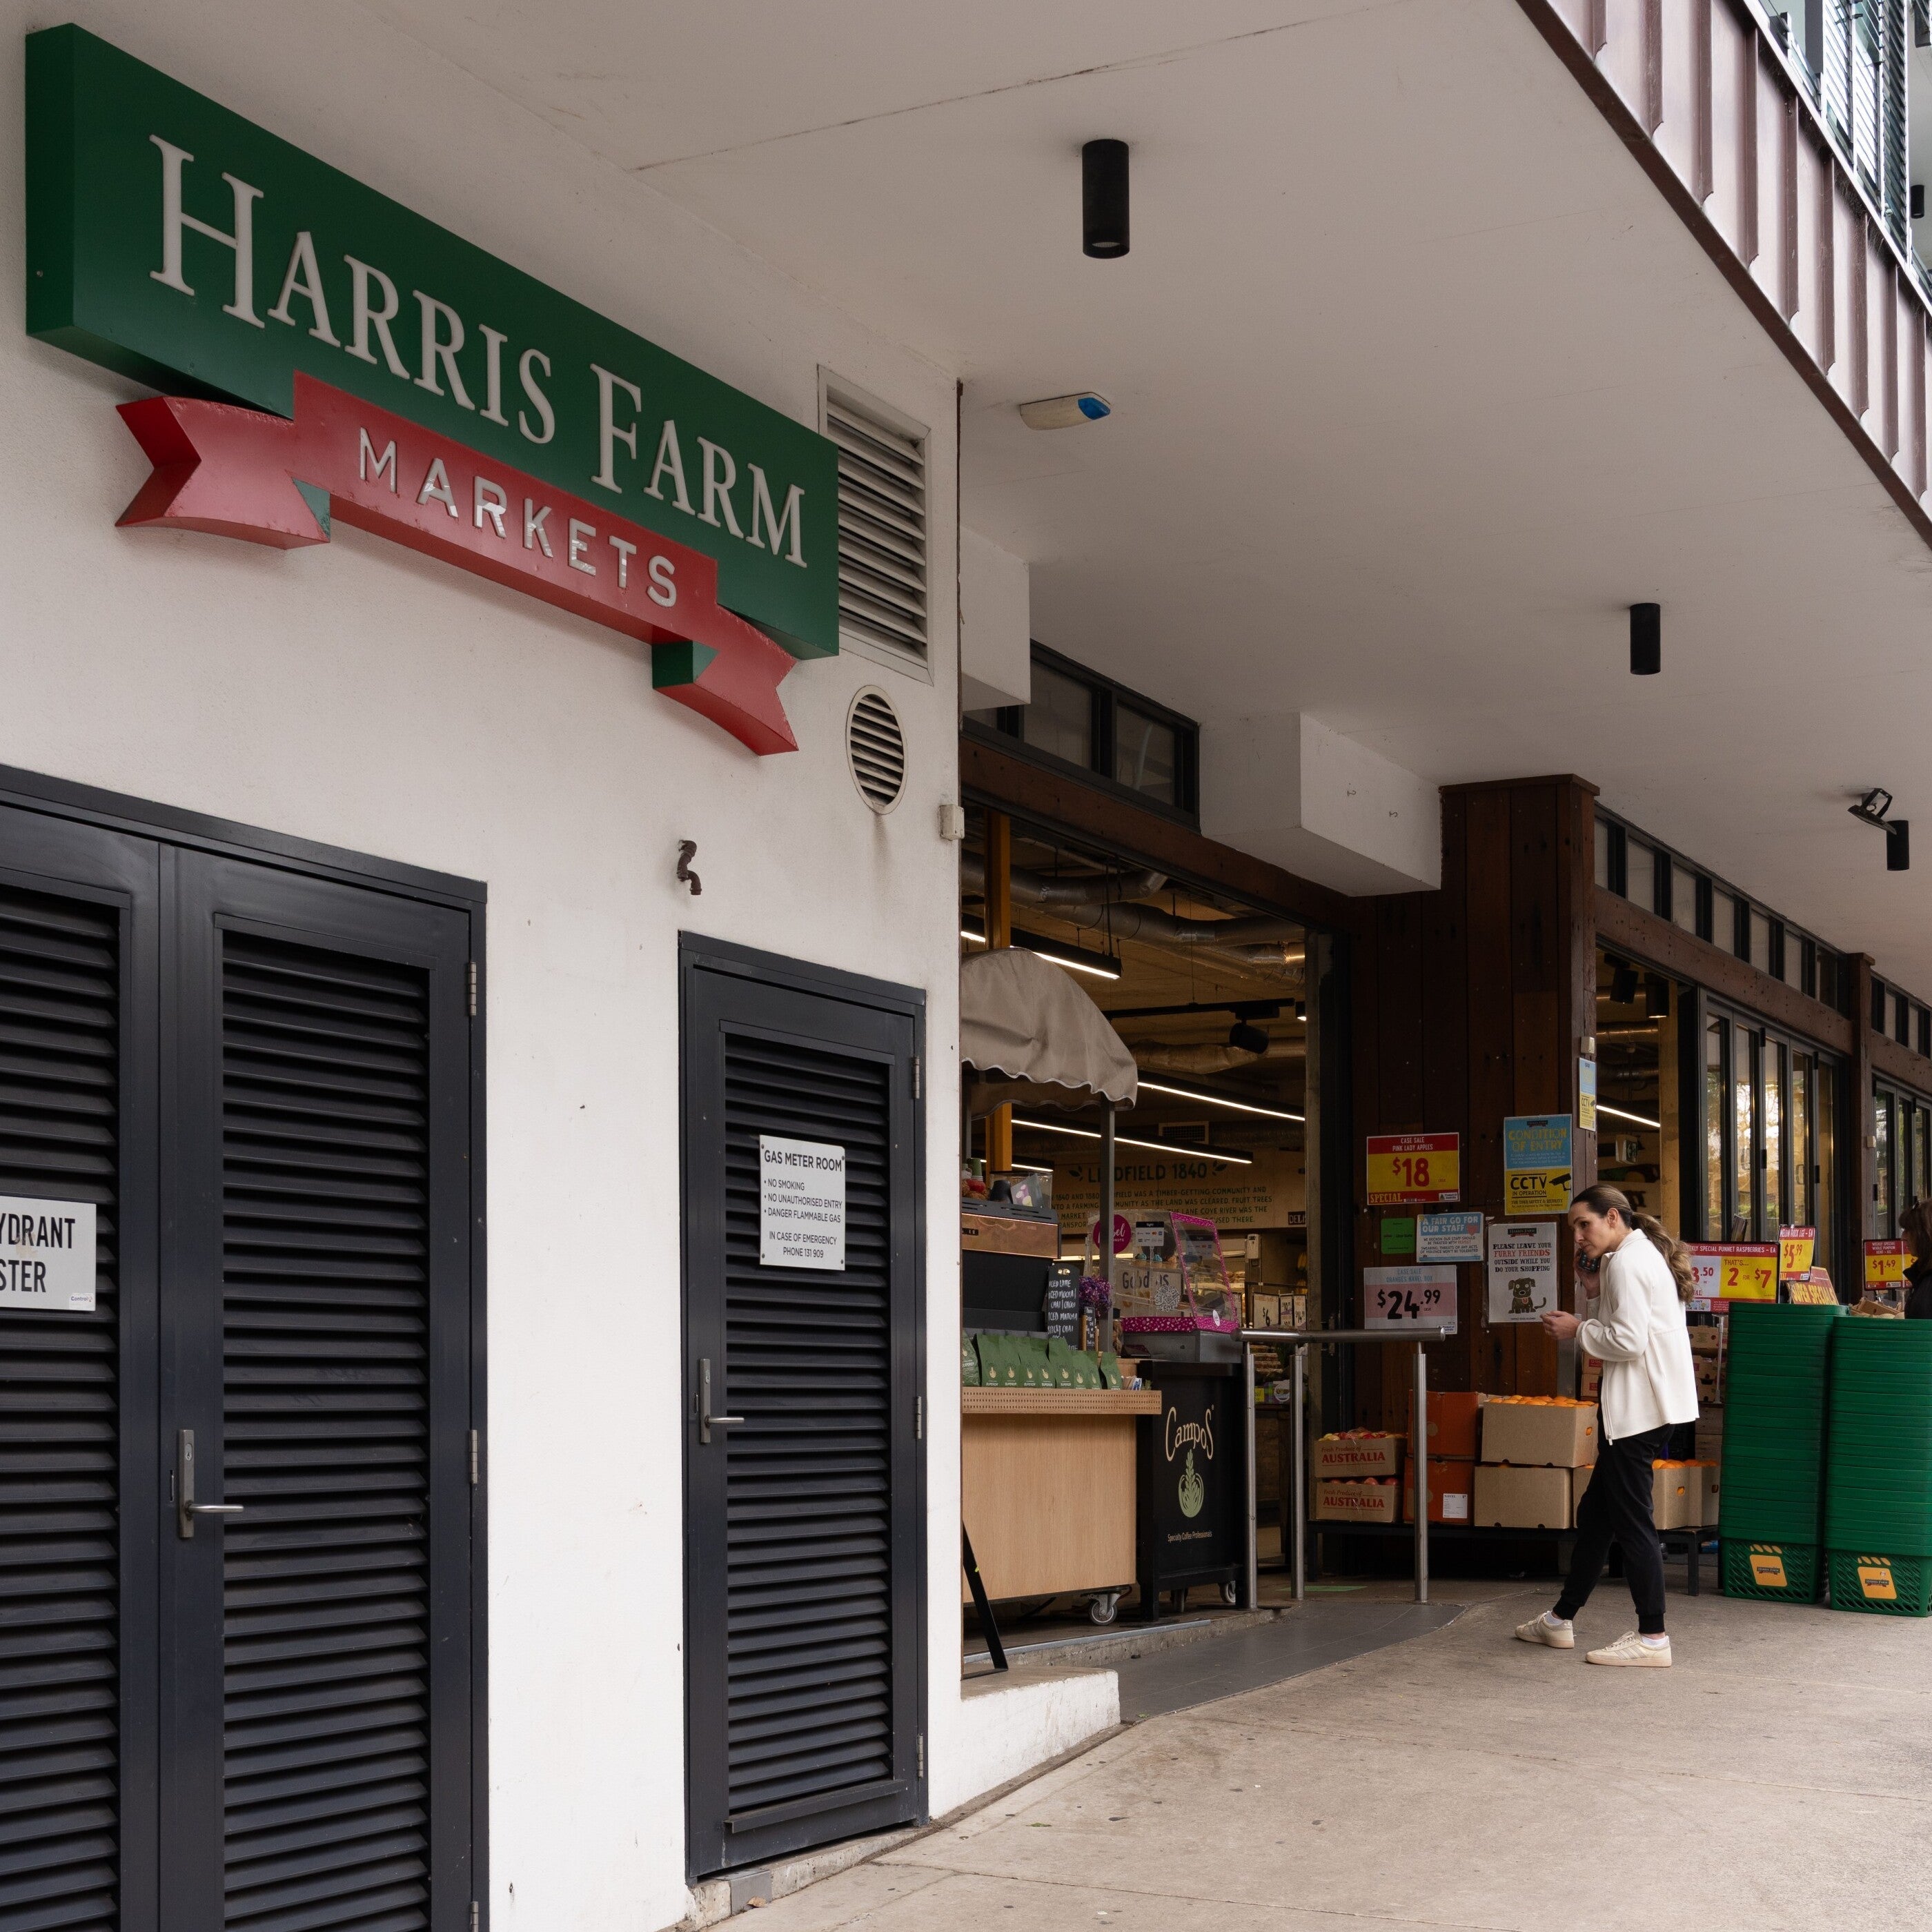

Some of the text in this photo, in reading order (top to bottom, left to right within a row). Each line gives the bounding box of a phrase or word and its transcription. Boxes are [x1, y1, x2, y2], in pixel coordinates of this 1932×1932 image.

[149, 134, 807, 568] HARRIS FARM
[359, 427, 677, 607] MARKETS
[1512, 1140, 1563, 1152] OF ENTRY
[765, 1150, 842, 1172] GAS METER ROOM
[1088, 1162, 1208, 1183] LIDFIELD 1840
[1392, 1156, 1430, 1187] $18
[768, 1179, 805, 1190] NO SMOKING
[1510, 1176, 1547, 1190] CCTV
[1212, 1187, 1250, 1195] COMMUNITY
[1370, 1193, 1403, 1203] SPECIAL
[768, 1193, 842, 1210] NO UNAUTHORISED ENTRY
[1165, 1198, 1182, 1206] LAND
[768, 1208, 840, 1223] DANGER FLAMMABLE GAS
[769, 1231, 837, 1245] IN CASE OF EMERGENCY
[783, 1247, 803, 1256] PHONE
[813, 1250, 824, 1258] 909
[1784, 1243, 1803, 1268] $5.99
[1873, 1259, 1895, 1275] $1.49
[1728, 1268, 1739, 1286] 2
[1755, 1268, 1771, 1288] $7
[1377, 1289, 1441, 1319] $24.99
[1049, 1312, 1058, 1321] ICED
[1322, 1452, 1386, 1463] AUSTRALIA
[1323, 1497, 1384, 1508] AUSTRALIA
